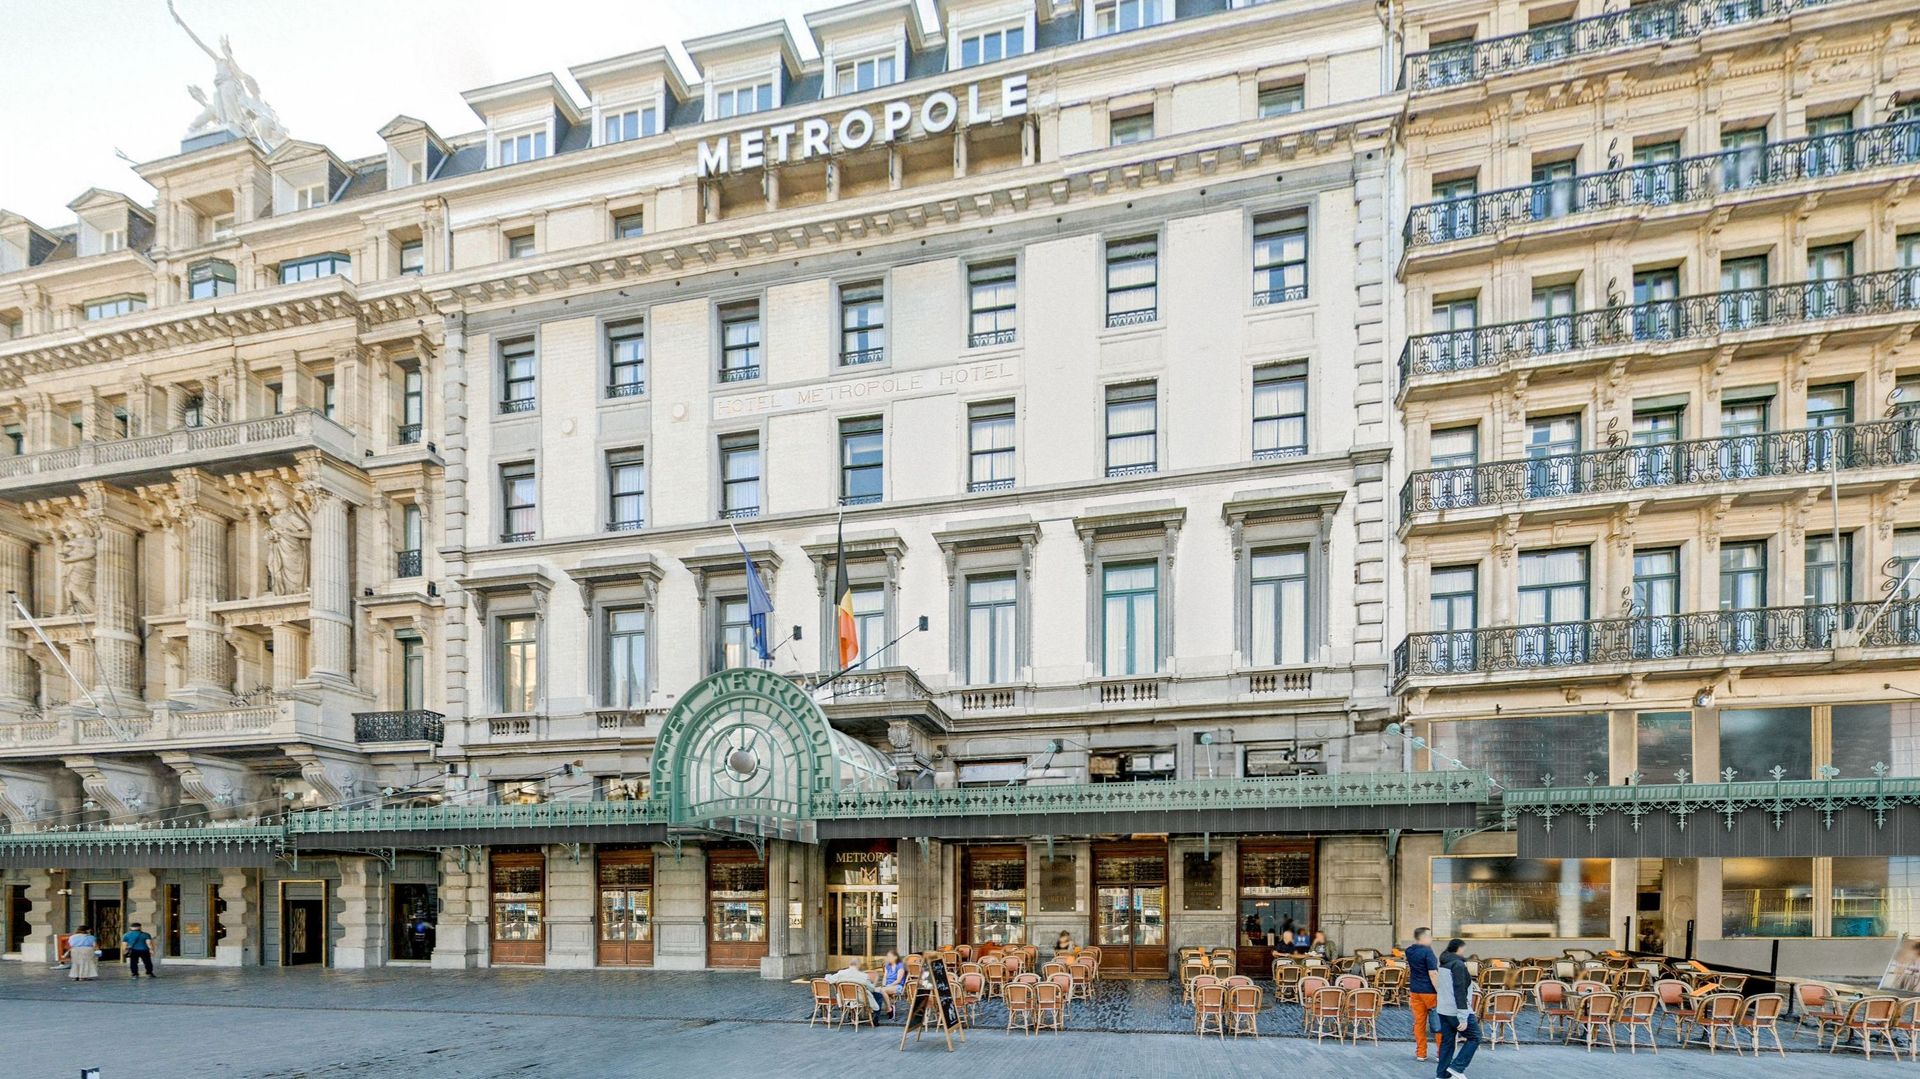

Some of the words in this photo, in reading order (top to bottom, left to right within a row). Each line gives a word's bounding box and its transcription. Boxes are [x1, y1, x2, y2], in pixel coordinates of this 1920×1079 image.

[698, 75, 1027, 177] METROPOLE
[718, 394, 783, 415] HOTEL
[798, 375, 924, 404] METROPOLE
[939, 362, 1013, 386] HOTEL
[656, 703, 694, 797] HOTEL
[708, 672, 832, 793] METROPOLE
